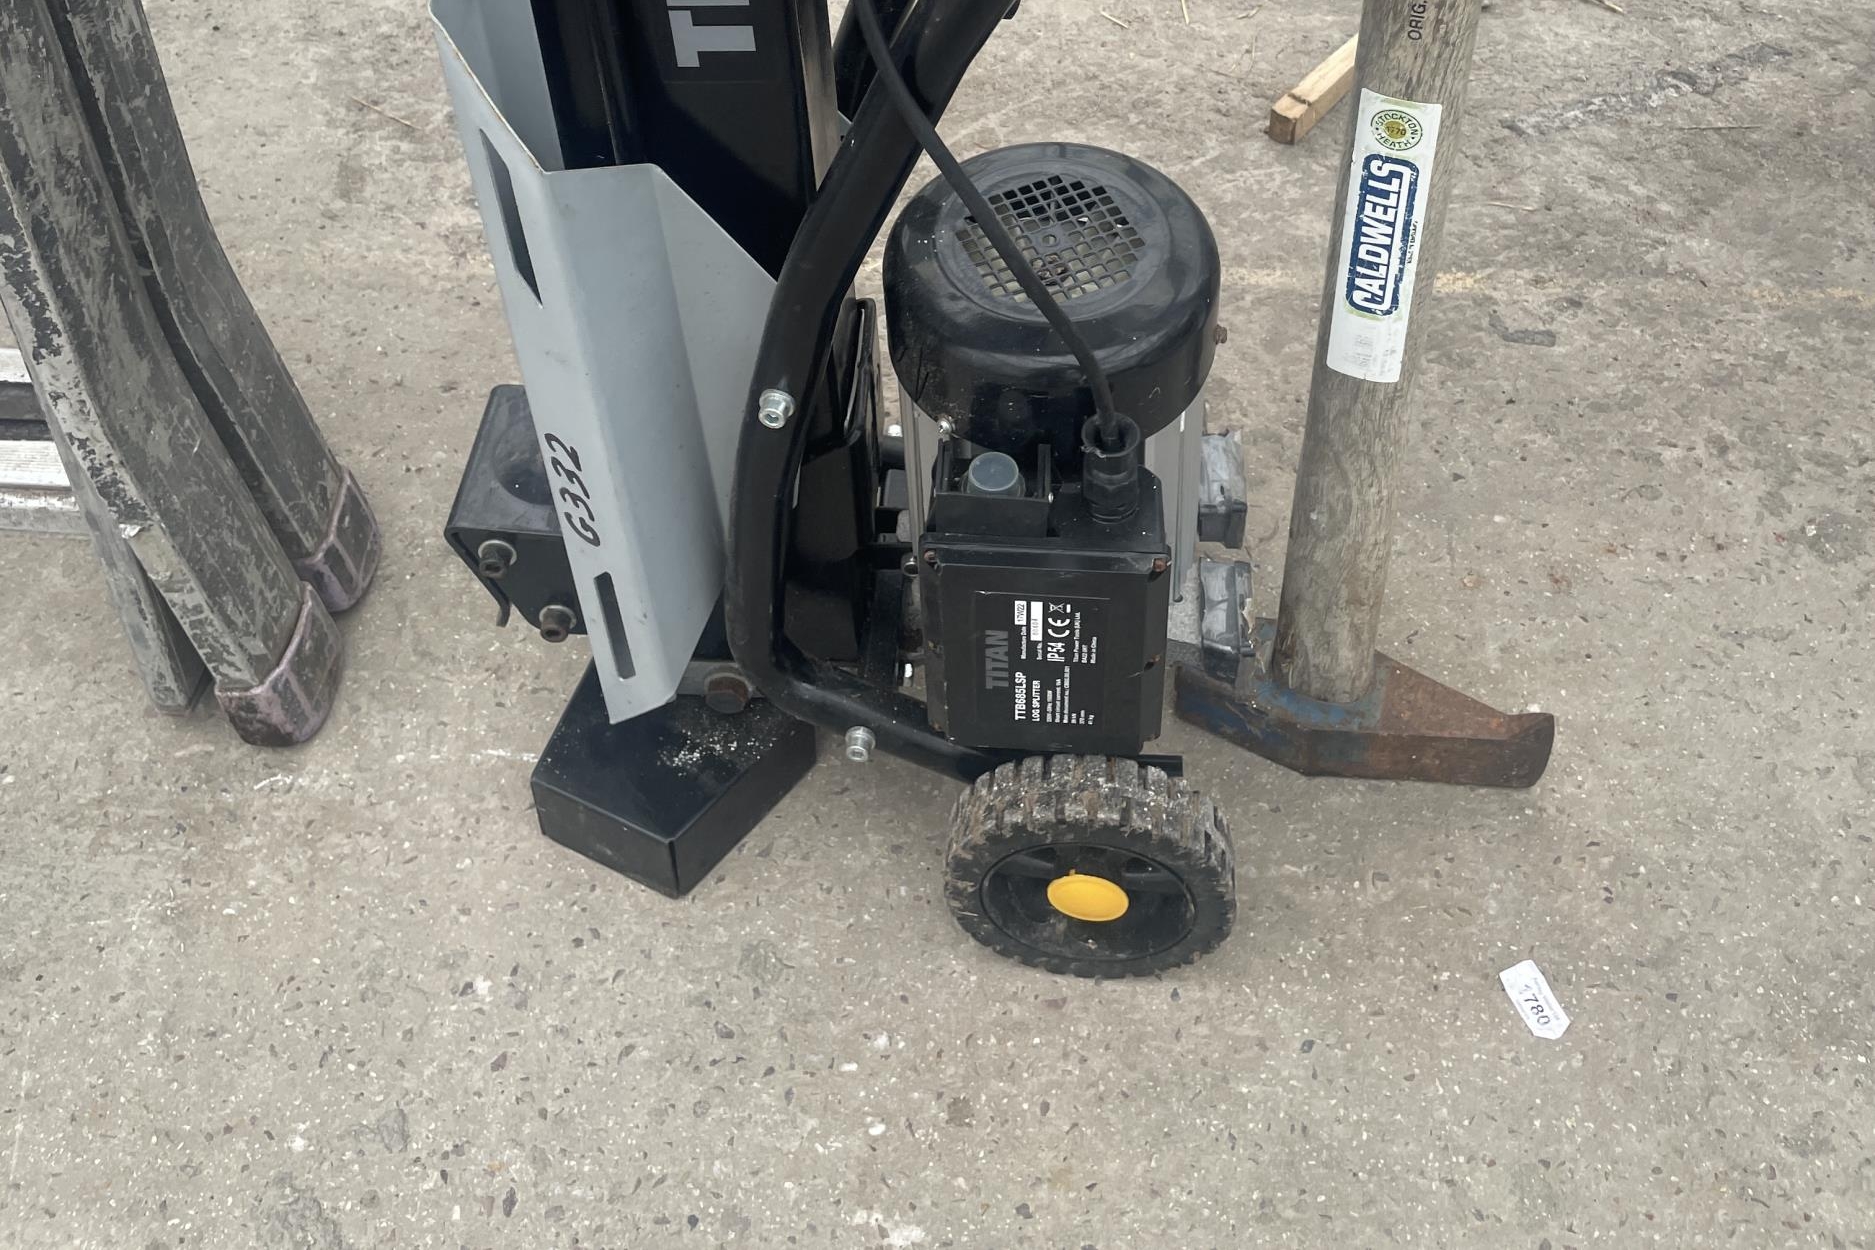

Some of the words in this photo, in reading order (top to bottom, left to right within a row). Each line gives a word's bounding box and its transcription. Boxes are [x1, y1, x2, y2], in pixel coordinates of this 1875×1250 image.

[1407, 0, 1428, 41] ORIG.
[1374, 112, 1419, 137] STOCKTON
[1377, 134, 1412, 149] HEATH
[1352, 158, 1412, 311] CALDWELLS
[544, 433, 600, 547] G332
[1047, 618, 1070, 638] CE
[985, 630, 1009, 689] TITAN
[1046, 642, 1065, 662] IP54
[1015, 671, 1026, 720] TTB685LSP
[1032, 680, 1040, 709] SPLITTER
[1032, 709, 1040, 721] LOG
